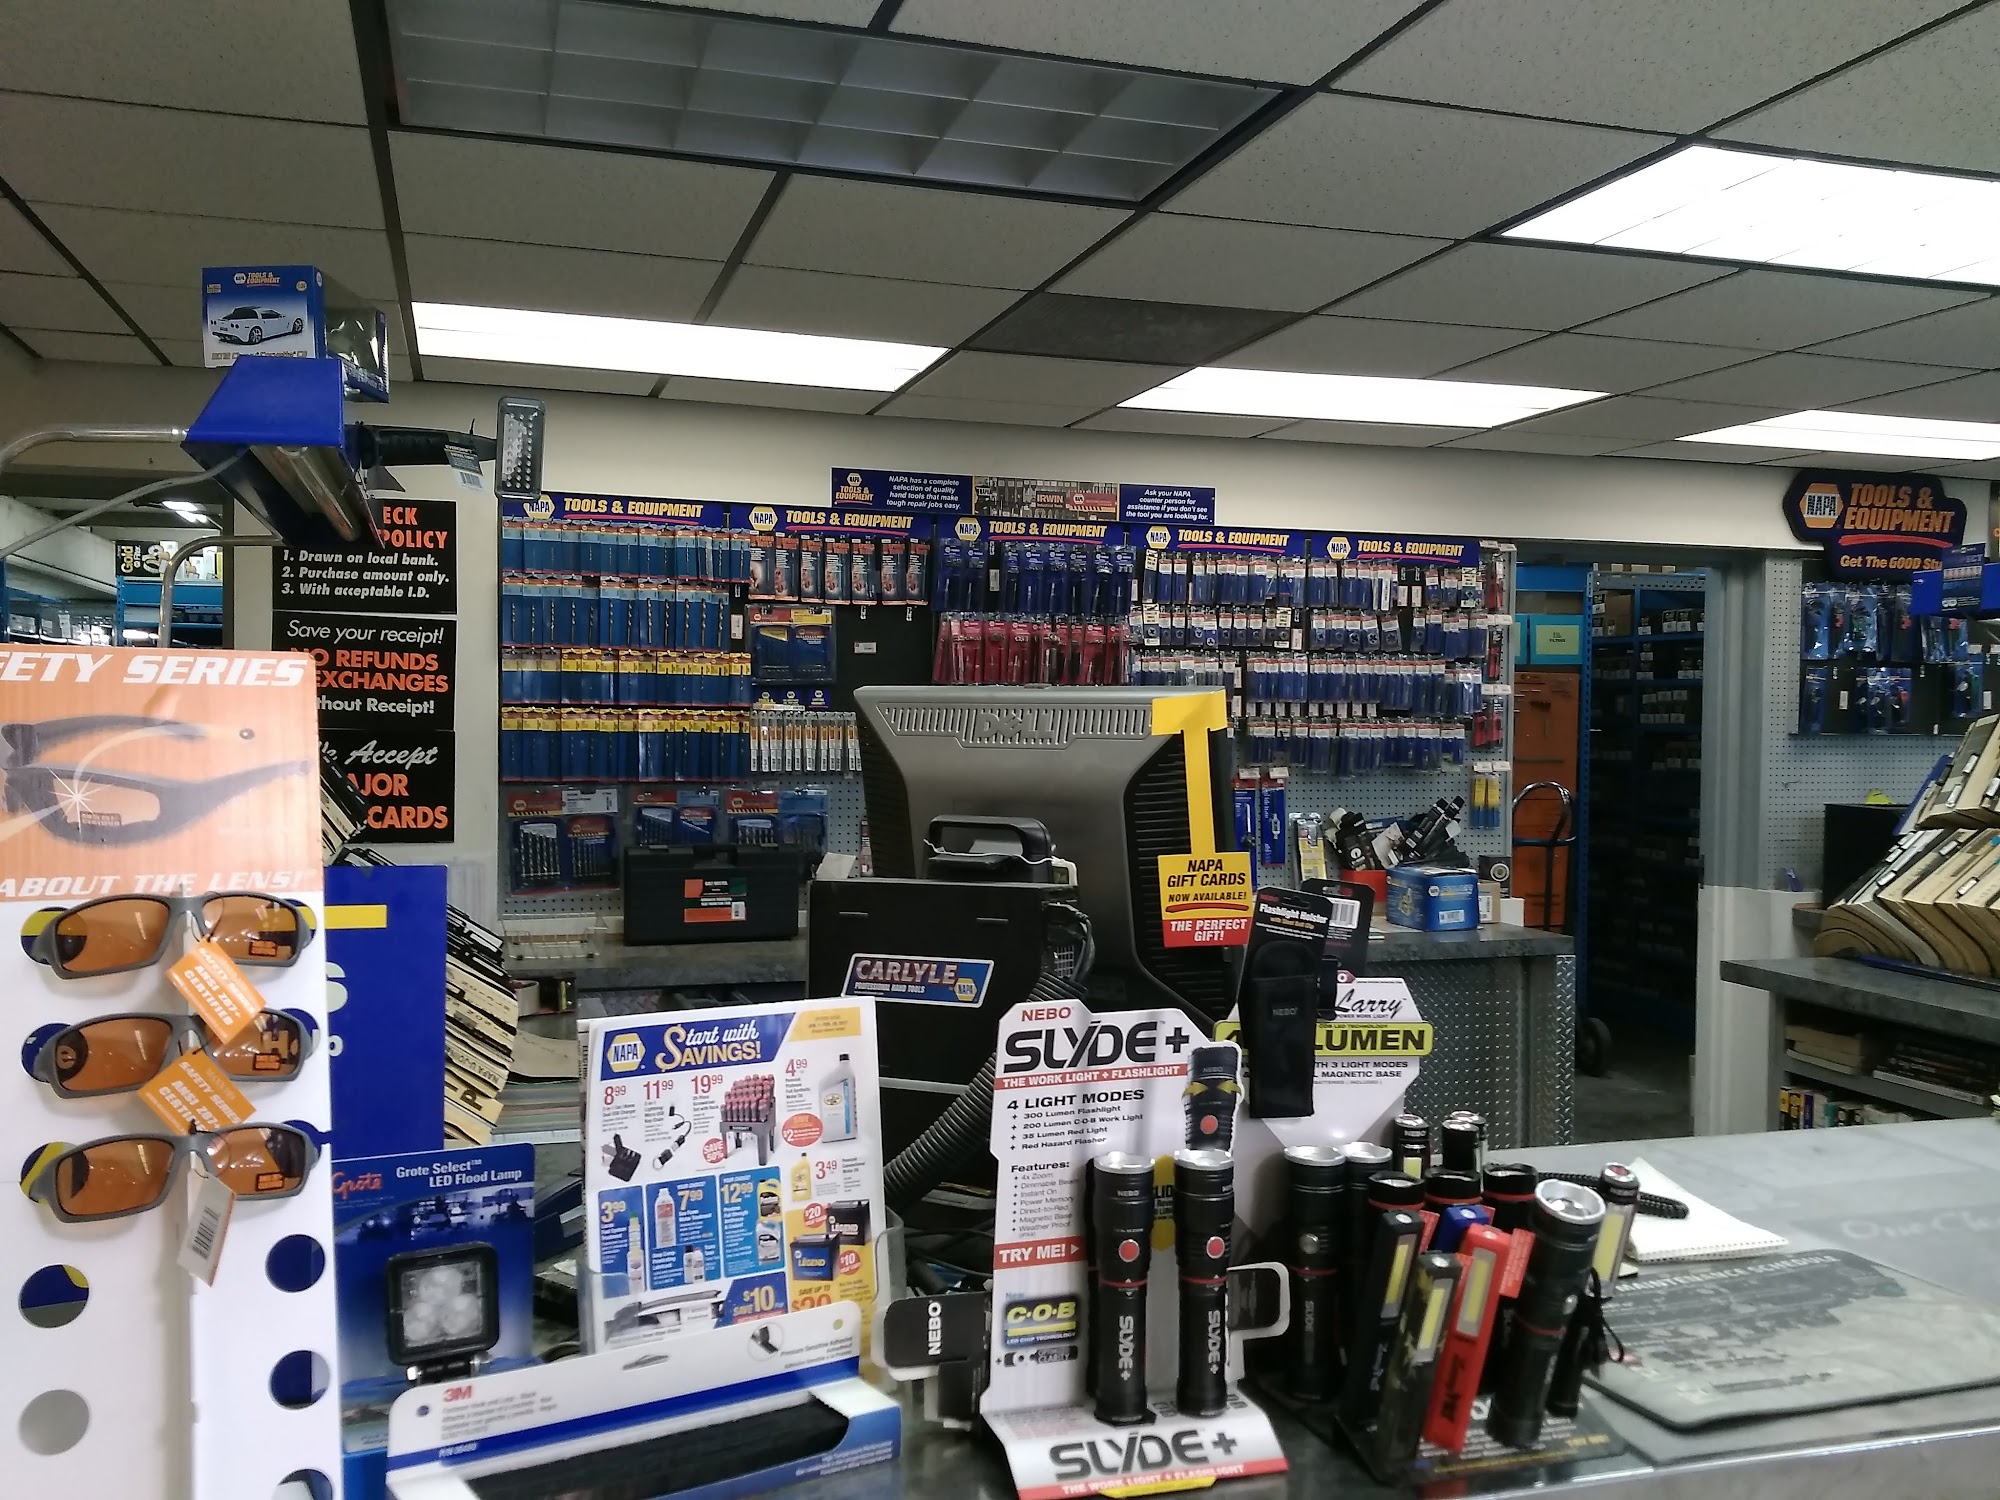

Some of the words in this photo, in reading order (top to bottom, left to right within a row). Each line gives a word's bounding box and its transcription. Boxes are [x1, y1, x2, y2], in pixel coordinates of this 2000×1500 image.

[888, 475, 909, 484] NAPA
[909, 477, 922, 485] has
[928, 478, 960, 487] complete
[835, 492, 874, 502] EQUIPMENT
[840, 485, 862, 494] TOOLS
[889, 491, 907, 499] hand
[940, 494, 959, 502] make
[892, 484, 923, 493] selection
[932, 487, 956, 495] quality
[1144, 488, 1157, 497] Ask
[1158, 490, 1173, 498] your
[1173, 489, 1192, 498] NAPA
[1849, 483, 1913, 508] TOOLS
[886, 499, 906, 509] tough
[907, 500, 927, 509] repair
[927, 501, 943, 510] jobs
[944, 502, 962, 511] easy.
[1036, 494, 1064, 504] IRWIN
[1139, 497, 1164, 505] counter
[1164, 498, 1189, 506] person
[1805, 493, 1838, 517] NAPA
[528, 503, 551, 514] NAPA
[563, 498, 608, 514] TOOLS
[627, 502, 704, 518] EQUIPMENT
[1126, 504, 1159, 512] assistance
[1166, 506, 1179, 514] you
[1179, 505, 1198, 514] don't
[753, 512, 774, 525] NAPA
[786, 510, 826, 525] TOOLS
[829, 512, 841, 526] &
[844, 513, 914, 529] EQUIPMENT
[1149, 513, 1162, 521] you
[1174, 513, 1198, 522] looking
[1843, 507, 1956, 534] EQUIPMENT
[959, 523, 978, 536] NAPA
[989, 520, 1026, 536] TOOLS
[1042, 523, 1108, 538] EQUIPMENT
[1150, 531, 1168, 544] NAPA
[1178, 529, 1213, 543] TOOLS
[1228, 532, 1290, 547] EQUIPMENT
[1329, 542, 1349, 554] NAPA
[1358, 540, 1391, 553] TOOLS
[1405, 543, 1465, 557] EQUIPMENT
[120, 545, 134, 574] Gold
[298, 550, 343, 563] Drawn
[347, 555, 364, 565] on
[367, 551, 398, 566] local
[402, 552, 439, 567] bank.
[1840, 554, 1864, 568] Get
[1865, 556, 1888, 569] The
[1888, 557, 1922, 570] GOOD
[298, 567, 359, 580] Purchase
[362, 569, 414, 582] amount
[417, 571, 450, 585] only.
[299, 583, 331, 596] With
[334, 585, 404, 600] acceptable
[407, 586, 430, 599] I.D.
[286, 619, 331, 638] Save
[333, 628, 376, 645] your
[379, 626, 445, 649] receipt!
[336, 650, 439, 671] REFUNDS
[122, 654, 309, 687] SERIES
[316, 670, 449, 693] EXCHANGES
[366, 697, 435, 717] Receipt!
[344, 739, 438, 770] Accept
[367, 805, 448, 830] CARDS
[1187, 858, 1224, 873] NAPA
[0, 874, 121, 897] ABOUT
[133, 873, 197, 893] THE
[1167, 874, 1198, 888] GIFT
[1200, 872, 1247, 887] CARDS
[1168, 893, 1191, 903] NOW
[1192, 891, 1247, 901] AVAILABLE!
[1259, 903, 1300, 919] Flashlight
[1170, 920, 1193, 932] THE
[1195, 919, 1248, 931] PERFECT
[1194, 930, 1225, 942] GIFT!
[855, 959, 958, 985] CARLYLE
[907, 985, 926, 994] TOOLS
[1334, 988, 1404, 1019] Larry
[1021, 1006, 1072, 1022] NEBO
[612, 1043, 639, 1063] NAPA
[722, 1019, 760, 1044] with
[1341, 1061, 1371, 1069] LIGHT
[1373, 1060, 1409, 1069] MODES
[1003, 1078, 1026, 1089] THE
[1028, 1075, 1063, 1086] WORK
[1065, 1071, 1100, 1083] LIGHT
[1111, 1066, 1180, 1079] FLASHLIGHT
[1321, 1070, 1373, 1079] MAGNETIC
[1375, 1070, 1403, 1078] BASE
[1007, 1099, 1019, 1110] 4
[1024, 1094, 1077, 1109] LIGHT
[1082, 1089, 1145, 1104] MODES
[1023, 1111, 1044, 1120] 300
[1045, 1109, 1076, 1118] Lumen
[1077, 1105, 1121, 1117] Flashlight
[1022, 1121, 1041, 1130] 200
[1043, 1118, 1072, 1128] Lumen
[1099, 1114, 1120, 1123] Work
[1122, 1113, 1143, 1123] Light
[1022, 1131, 1035, 1140] 35
[1037, 1129, 1066, 1139] Lumen
[1067, 1127, 1085, 1136] Red
[1086, 1126, 1108, 1136] Light
[1021, 1142, 1039, 1151] Red
[1041, 1138, 1072, 1149] Hazard
[1074, 1135, 1107, 1145] Flasher
[396, 1165, 430, 1179] Grote
[1011, 1160, 1070, 1174] Features:
[429, 1176, 453, 1189] LED
[455, 1171, 488, 1185] Flood
[490, 1168, 523, 1182] Lamp
[1032, 1172, 1054, 1180] Zoom
[1020, 1190, 1049, 1199] Instant
[1020, 1199, 1043, 1207] Power
[1044, 1196, 1074, 1206] Memory
[1117, 1189, 1140, 1198] NEBO
[1018, 1214, 1052, 1225] Magnetic
[1053, 1212, 1073, 1221] Base
[1018, 1223, 1050, 1233] Weather
[1051, 1220, 1071, 1230] Proof
[831, 1223, 859, 1232] LEGEND
[999, 1248, 1034, 1264] TRY
[1036, 1243, 1067, 1260] ME!
[798, 1258, 826, 1267] LEGEND
[1615, 1267, 1746, 1294] MAINTENANCE
[798, 1287, 813, 1296] SAVE
[733, 1304, 754, 1316] SAVE
[927, 1301, 943, 1356] NEBO
[443, 1385, 473, 1403] 3M
[1062, 1483, 1087, 1495] THE
[1089, 1479, 1123, 1492] WORK
[1174, 1464, 1245, 1481] FLASHLIGHT
